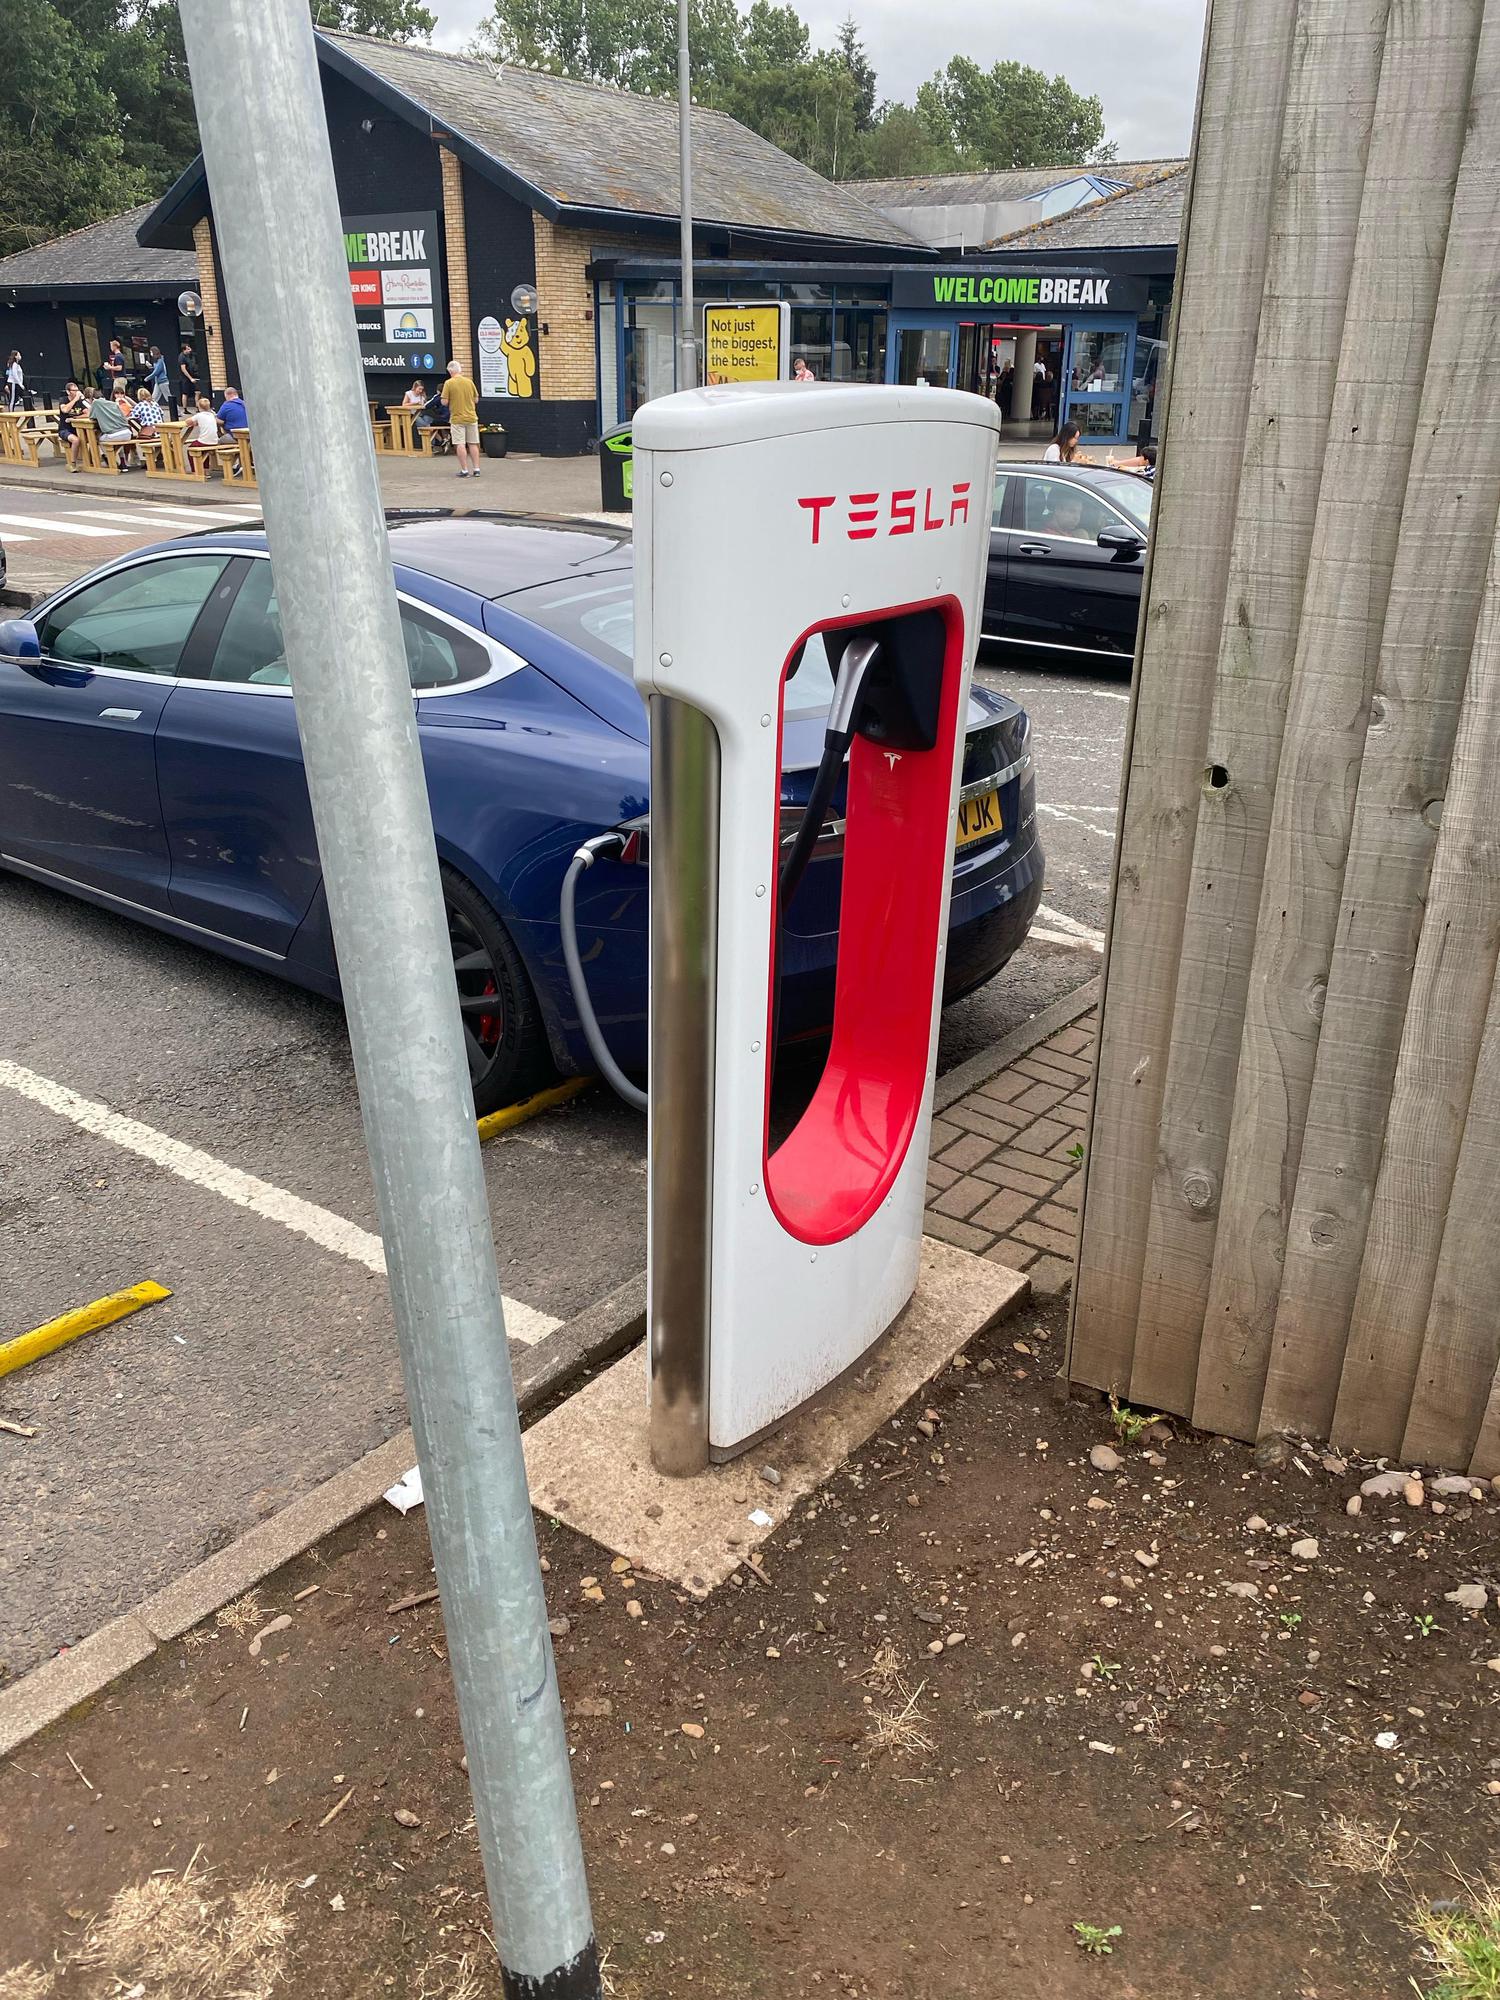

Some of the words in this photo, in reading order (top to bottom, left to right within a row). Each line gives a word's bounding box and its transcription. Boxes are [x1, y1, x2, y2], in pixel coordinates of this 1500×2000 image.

[343, 229, 427, 262] MEBREAK
[361, 283, 377, 293] KING
[933, 276, 1111, 305] WELCOMEBREAK
[394, 329, 413, 340] Days
[412, 328, 425, 338] Inn
[711, 319, 731, 332] Not
[734, 318, 756, 335] just
[711, 336, 729, 349] the
[731, 335, 776, 352] biggest,
[711, 353, 729, 367] the
[731, 353, 759, 367] best.
[797, 482, 971, 545] TESLA
